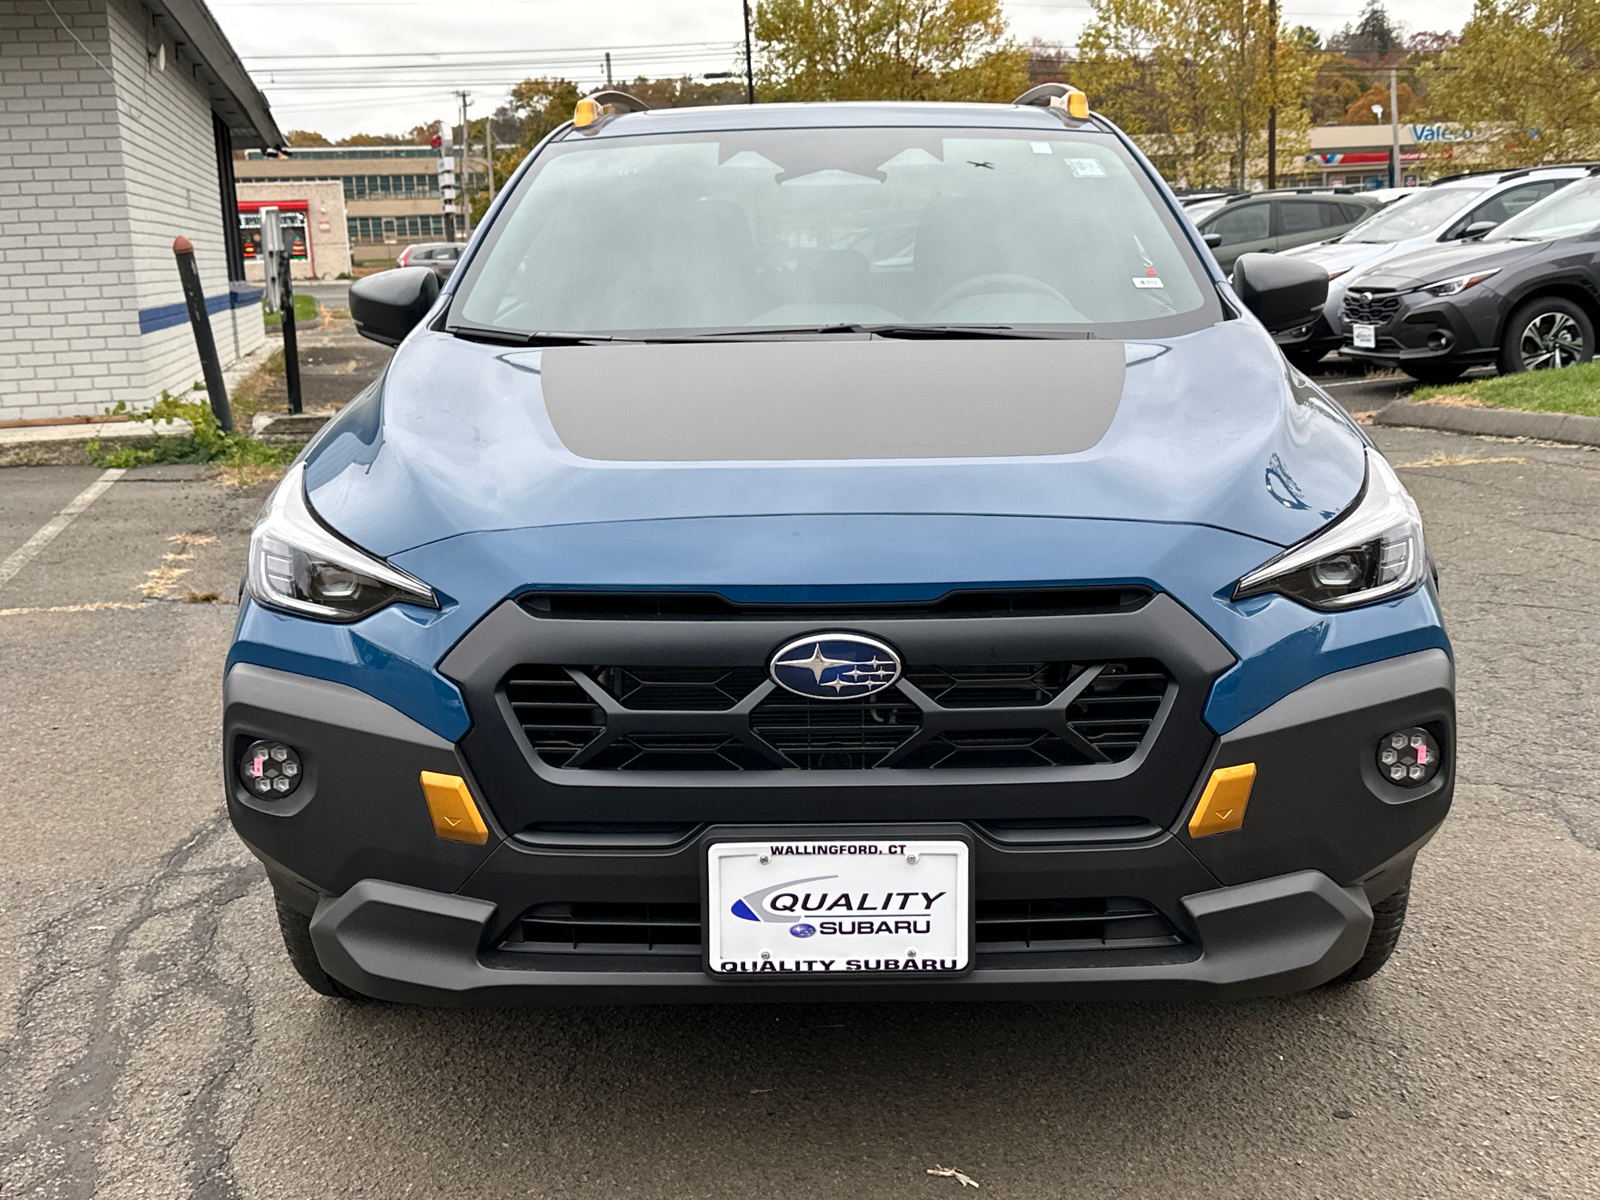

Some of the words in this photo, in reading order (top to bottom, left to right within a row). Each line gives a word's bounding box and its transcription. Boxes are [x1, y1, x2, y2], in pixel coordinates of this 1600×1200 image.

[1412, 124, 1474, 141] Valeo
[770, 844, 882, 856] WALLINGFORD,
[888, 843, 908, 855] CT
[770, 891, 947, 912] QUALITY
[819, 920, 931, 935] SUBARU
[720, 959, 836, 972] QUALITY
[845, 958, 957, 971] SUBARU
